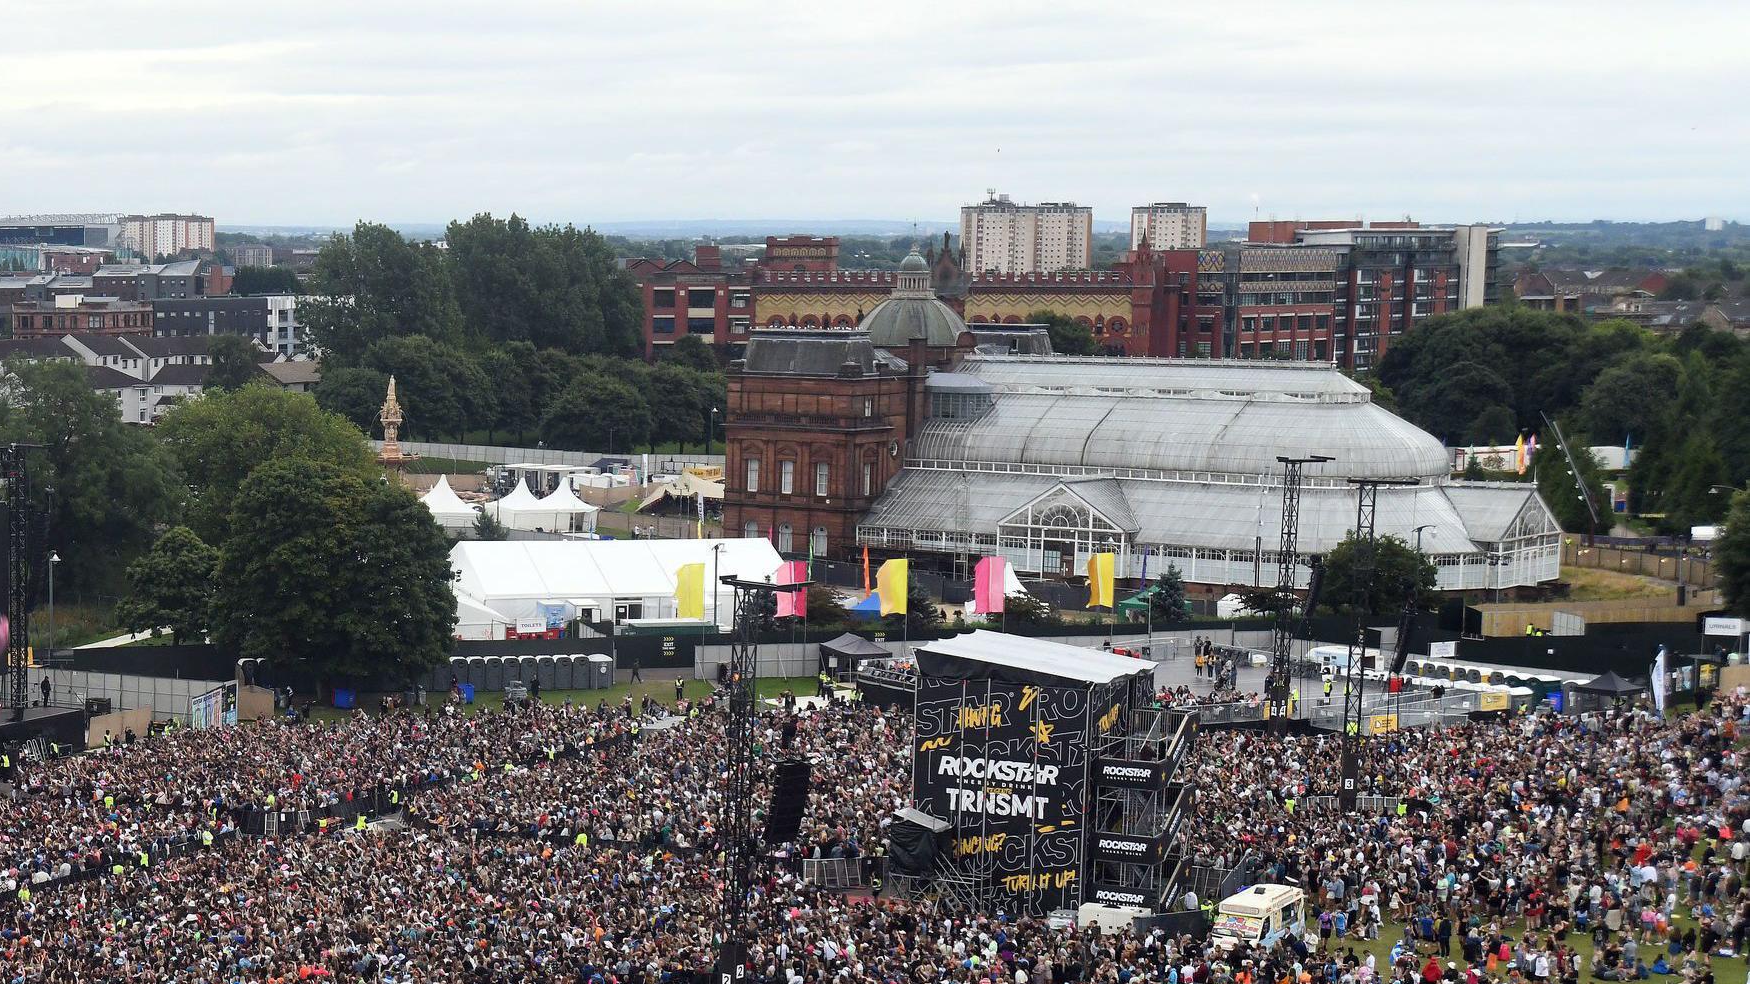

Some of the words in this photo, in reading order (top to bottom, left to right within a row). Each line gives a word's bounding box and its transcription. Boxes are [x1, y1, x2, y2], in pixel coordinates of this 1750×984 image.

[938, 755, 1059, 786] ROCKSTAR
[1103, 766, 1151, 778] ROCKSTAR
[1001, 782, 1033, 790] DRINK
[1346, 780, 1353, 789] 3
[945, 788, 1049, 819] TRNSMT
[1099, 840, 1147, 852] ROCKSTAR
[1096, 890, 1145, 904] ROCKSTAR
[738, 967, 743, 976] 2
